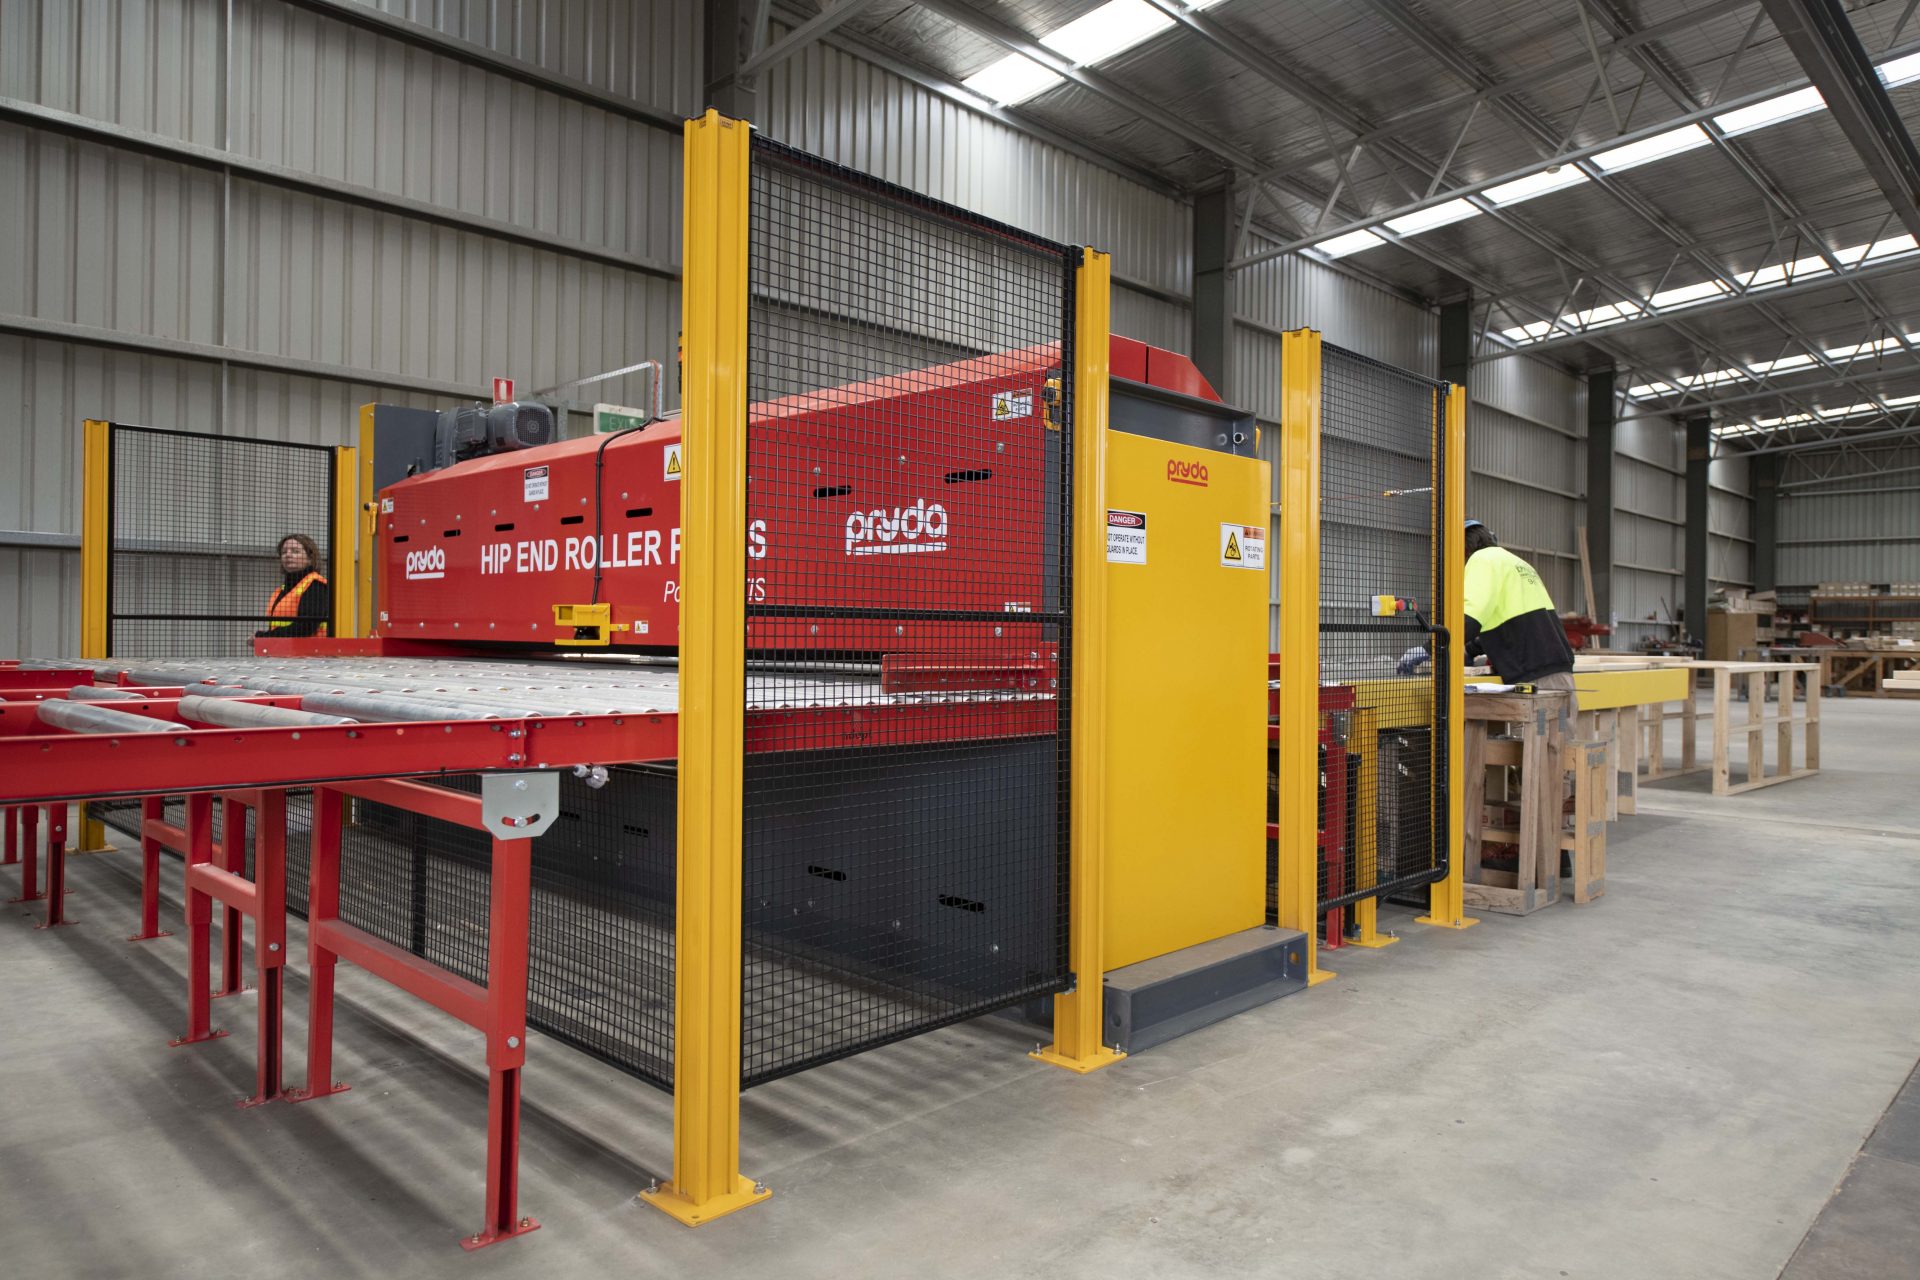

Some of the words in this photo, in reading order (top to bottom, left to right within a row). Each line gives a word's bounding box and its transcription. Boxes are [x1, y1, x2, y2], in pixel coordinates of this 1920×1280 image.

[1167, 459, 1208, 482] pryda
[846, 498, 948, 556] pryda
[1109, 514, 1136, 525] DANGER
[1113, 533, 1129, 543] OPERATE
[1130, 536, 1145, 544] WITHOUT
[1245, 545, 1264, 553] ROTATING
[406, 545, 445, 580] pryda
[481, 543, 511, 575] HIP
[517, 539, 558, 573] END
[565, 530, 662, 570] ROLLER
